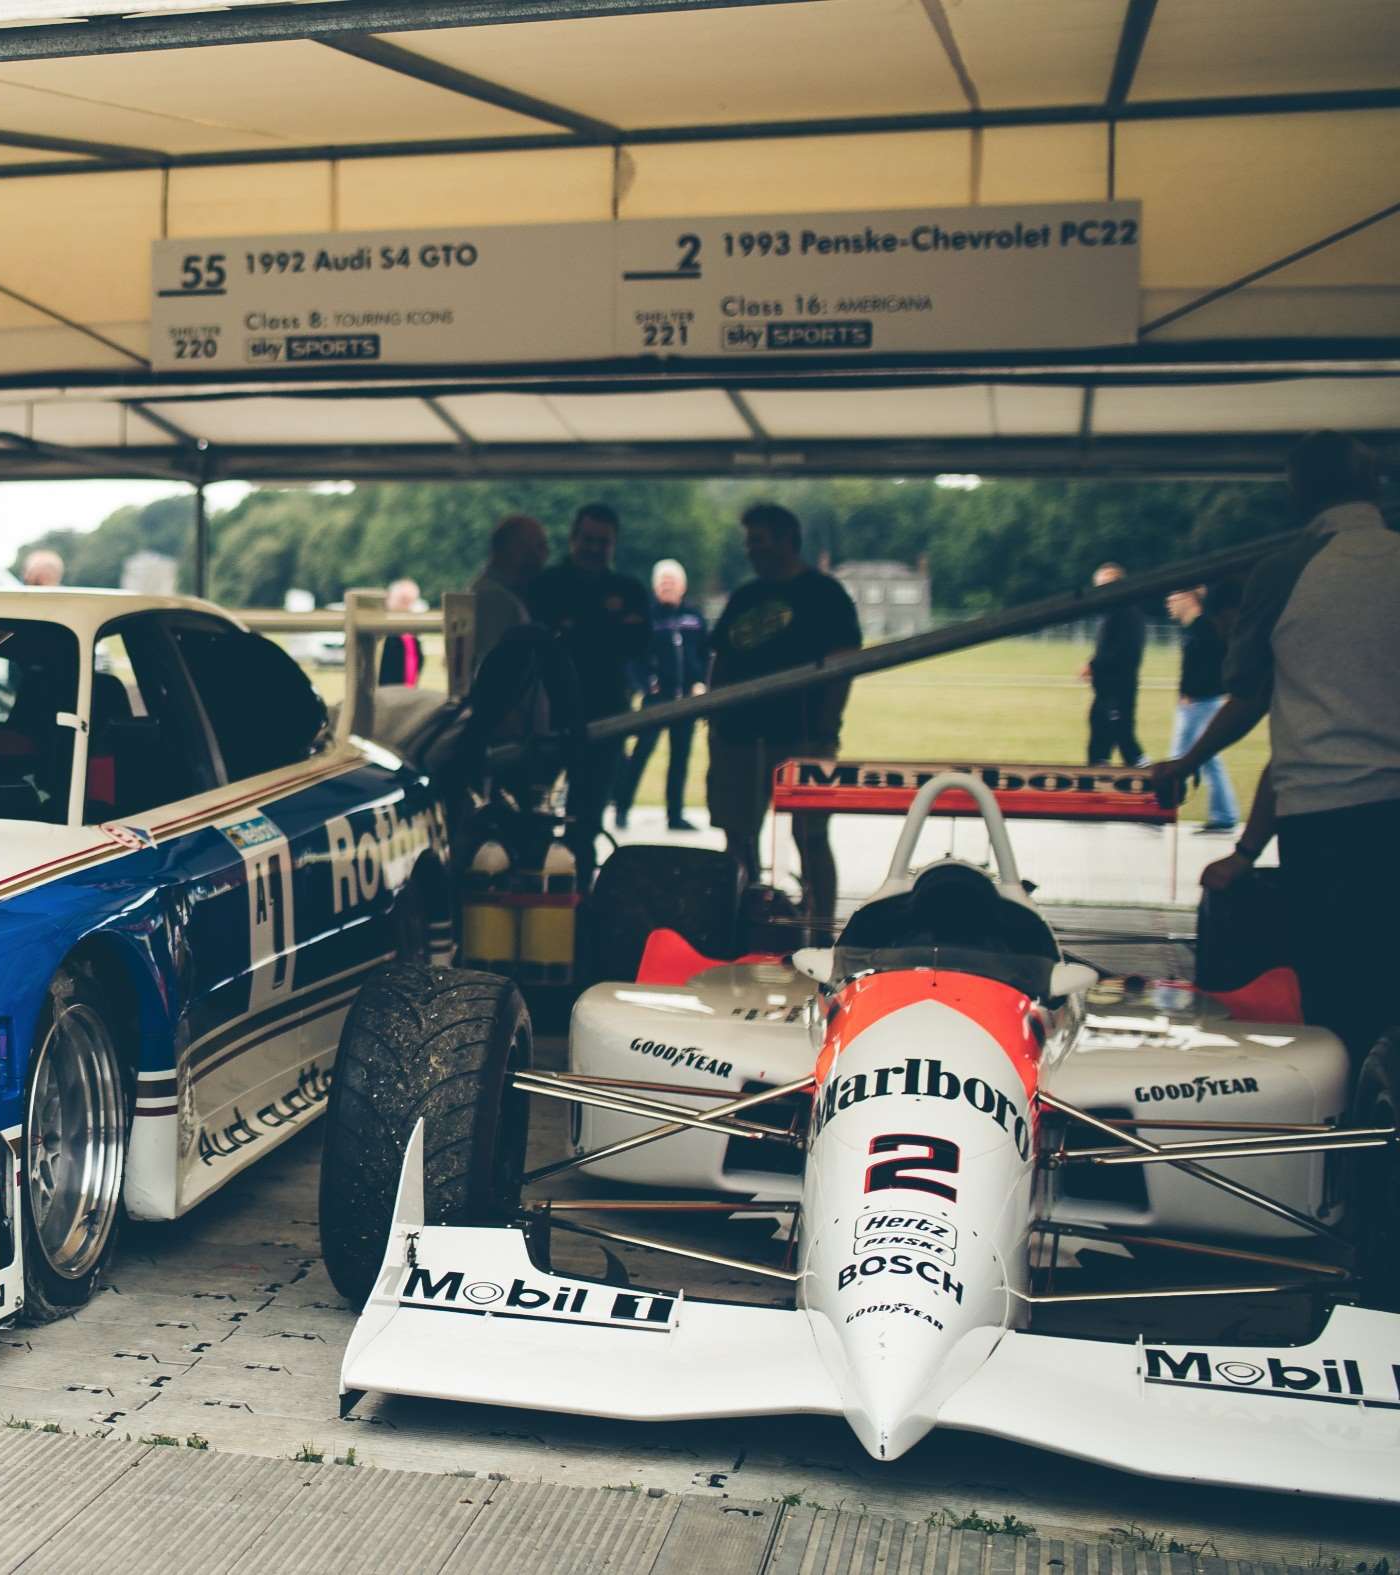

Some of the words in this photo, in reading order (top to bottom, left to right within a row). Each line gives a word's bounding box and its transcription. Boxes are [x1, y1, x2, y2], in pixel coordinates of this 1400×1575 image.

[675, 233, 701, 271] 2
[723, 231, 790, 257] 1993
[800, 221, 1050, 254] Penske-Chevrolet
[1060, 218, 1137, 246] PC22
[181, 255, 227, 289] 55
[245, 251, 305, 275] 1992
[312, 249, 371, 272] Audi
[380, 247, 411, 269] S4
[420, 244, 478, 268] GTO
[244, 311, 300, 331] Class
[332, 311, 402, 328] TOURING
[406, 309, 454, 325] ICONS
[720, 296, 783, 317] Class
[836, 294, 933, 312] AMERICANA
[174, 338, 217, 359] 220
[250, 336, 282, 360] sky
[289, 338, 376, 356] SPORTS
[642, 324, 688, 346] 221
[726, 327, 763, 349] sky
[772, 325, 867, 344] SPORTS
[800, 766, 1152, 794] Marboro
[199, 1106, 264, 1166] Audi
[864, 1132, 960, 1203] 2
[864, 1215, 949, 1238] Hertz
[863, 1236, 946, 1254] PENSKE
[402, 1266, 589, 1314] Mobil
[838, 1255, 964, 1305] BOSCH
[1145, 1348, 1364, 1395] Mobil
